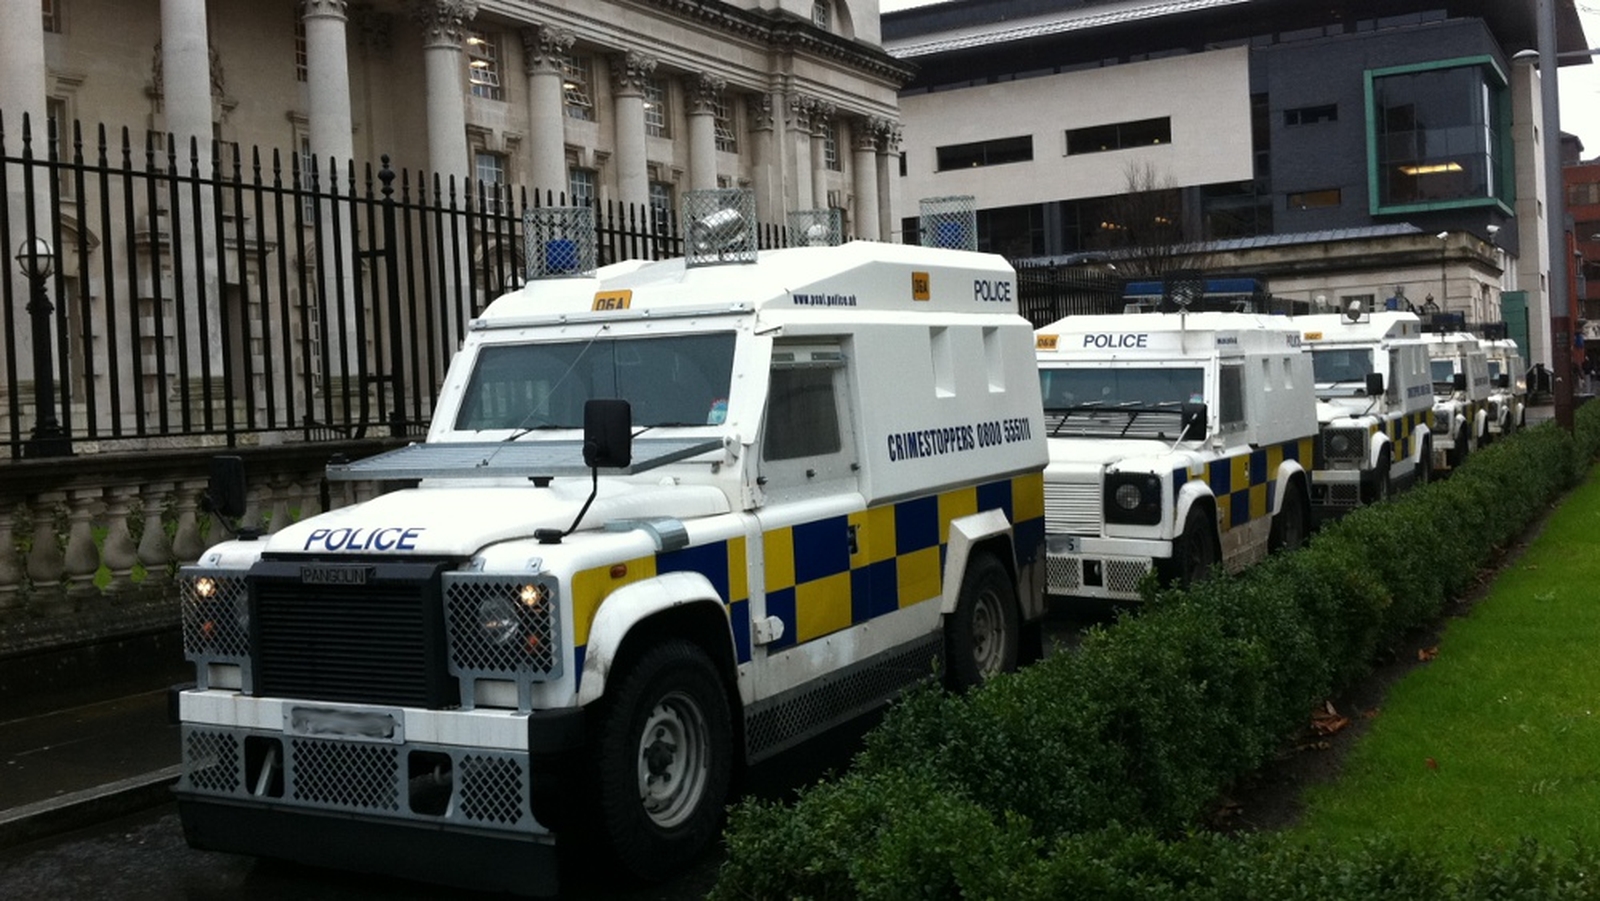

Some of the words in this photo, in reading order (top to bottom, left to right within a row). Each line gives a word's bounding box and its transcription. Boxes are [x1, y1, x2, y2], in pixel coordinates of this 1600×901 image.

[974, 279, 1011, 301] POLICE
[595, 297, 624, 311] 06A
[1083, 334, 1148, 348] POLICE
[887, 424, 975, 462] CRIMESTOPPERS
[976, 420, 1003, 448] 0800
[1003, 417, 1031, 444] 555111
[303, 527, 426, 551] POLICE
[303, 567, 364, 583] PANGOLIN
